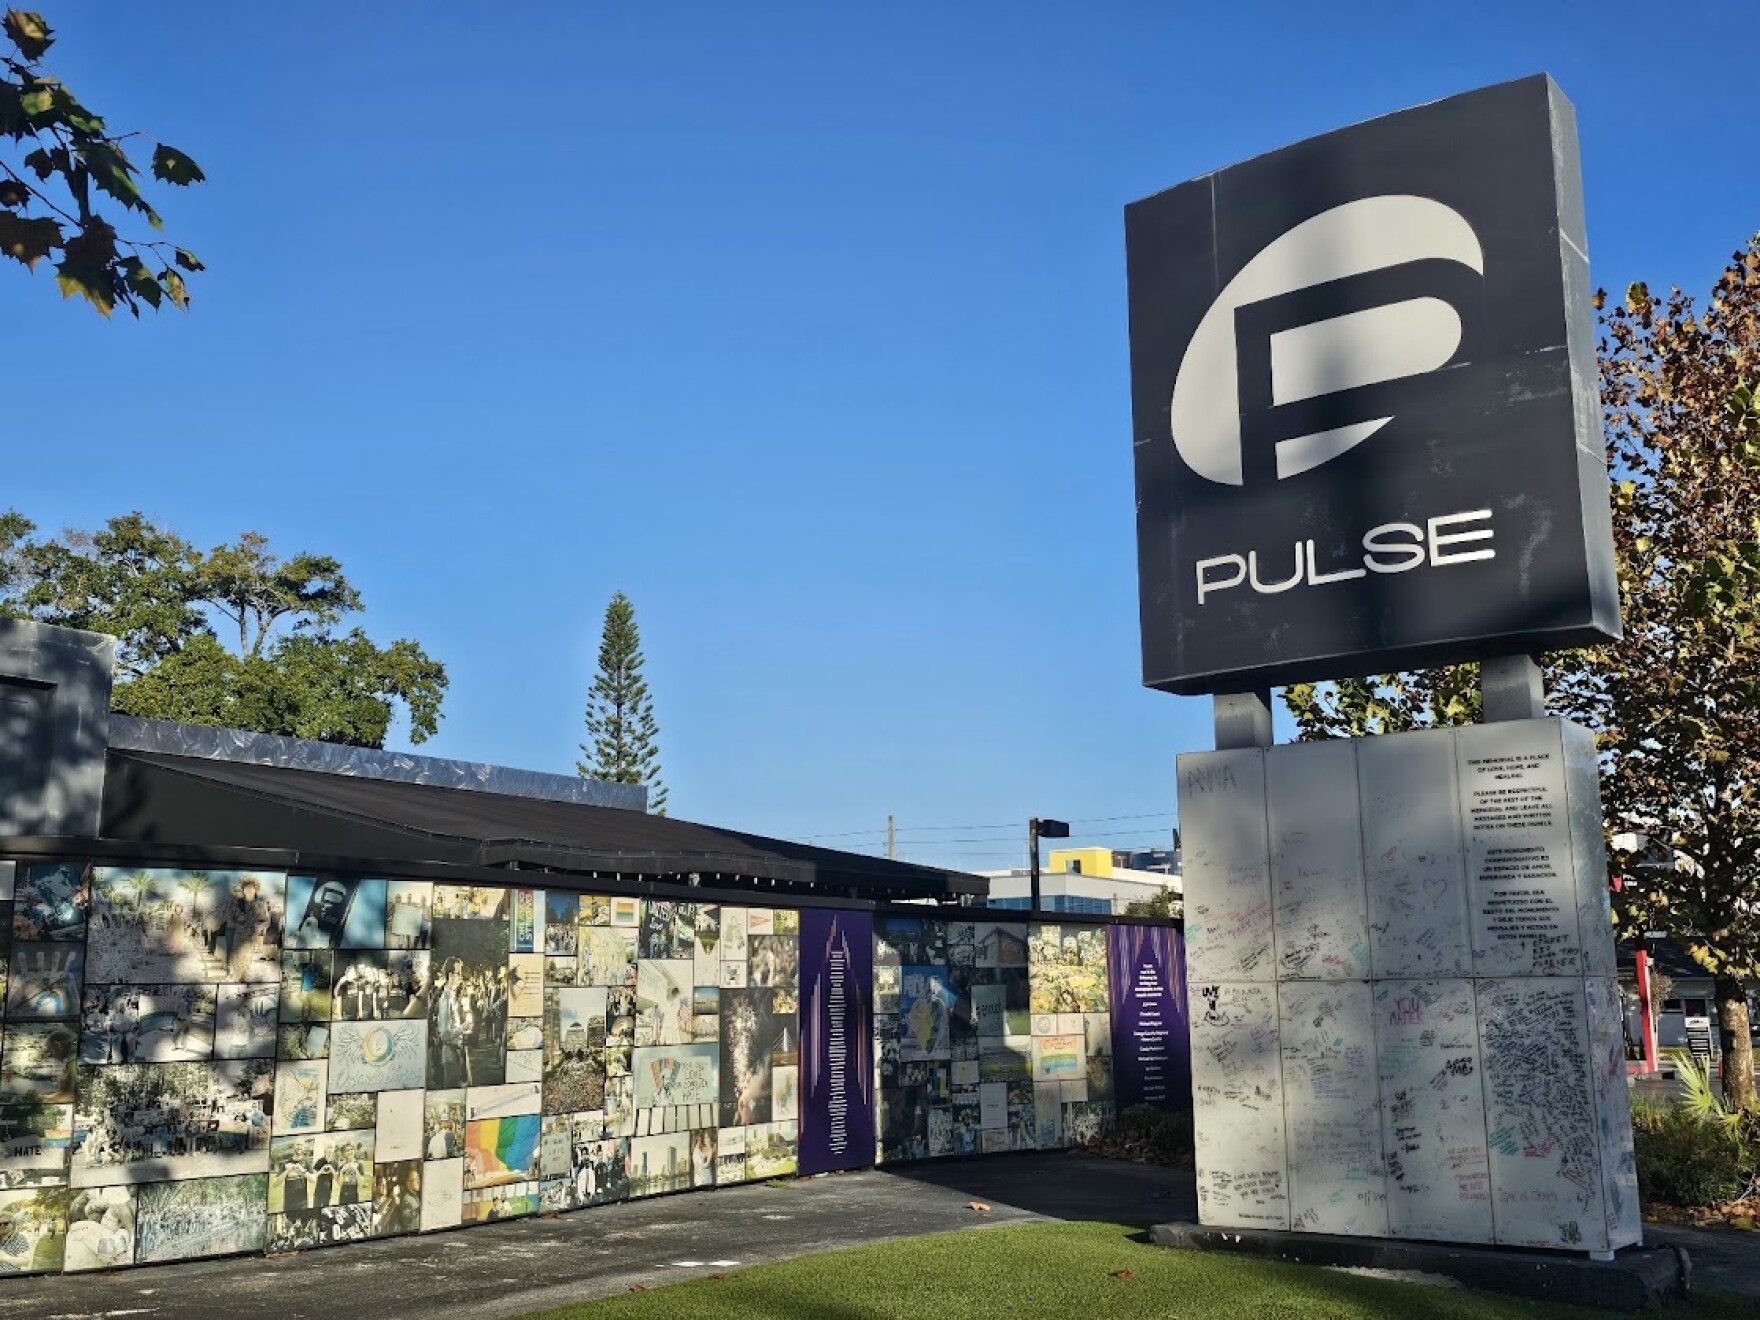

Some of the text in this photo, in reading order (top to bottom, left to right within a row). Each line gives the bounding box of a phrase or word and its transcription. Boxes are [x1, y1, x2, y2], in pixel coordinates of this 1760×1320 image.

[1195, 509, 1495, 605] PULSE
[1504, 846, 1545, 854] MONUMENTO
[1394, 997, 1420, 1013] YOU
[14, 1145, 42, 1157] HATE
